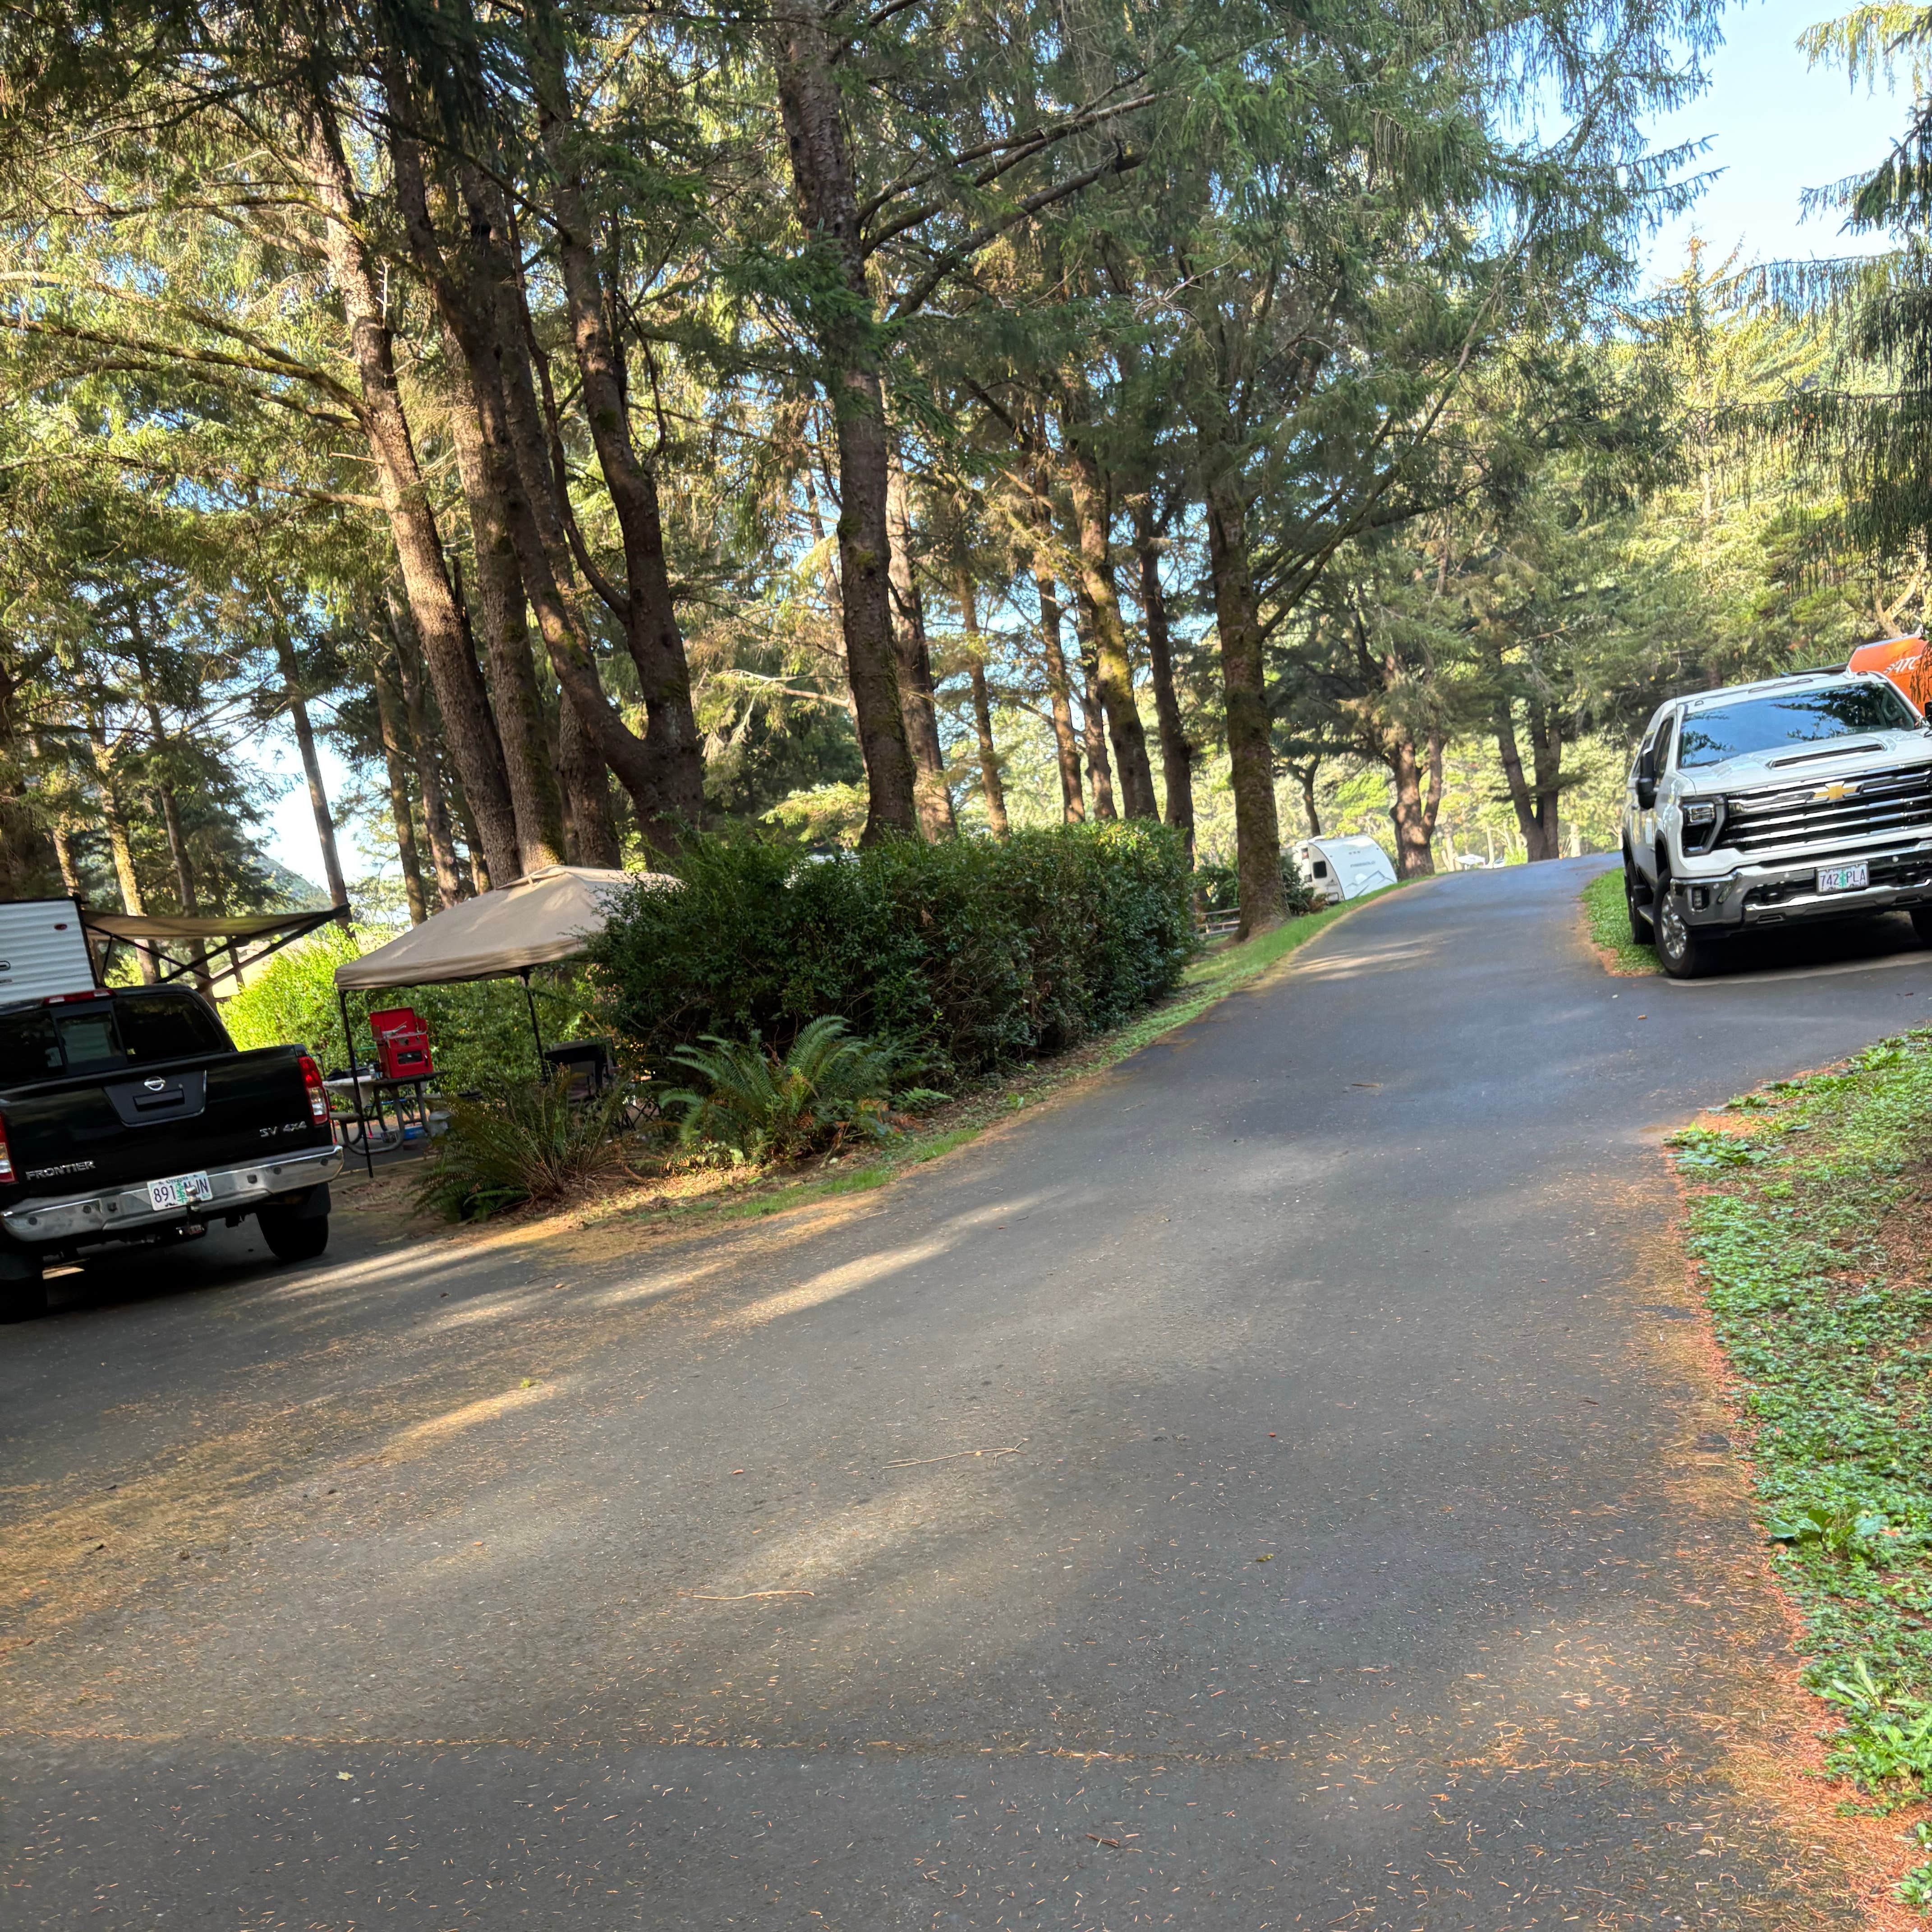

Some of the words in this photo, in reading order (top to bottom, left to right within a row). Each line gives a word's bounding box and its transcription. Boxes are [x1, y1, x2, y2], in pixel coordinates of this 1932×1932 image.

[1820, 873, 1839, 888] 742
[1846, 869, 1866, 883] PLA
[259, 1126, 278, 1138] SV
[25, 1160, 96, 1181] FRONTIER
[153, 1185, 176, 1203] 891
